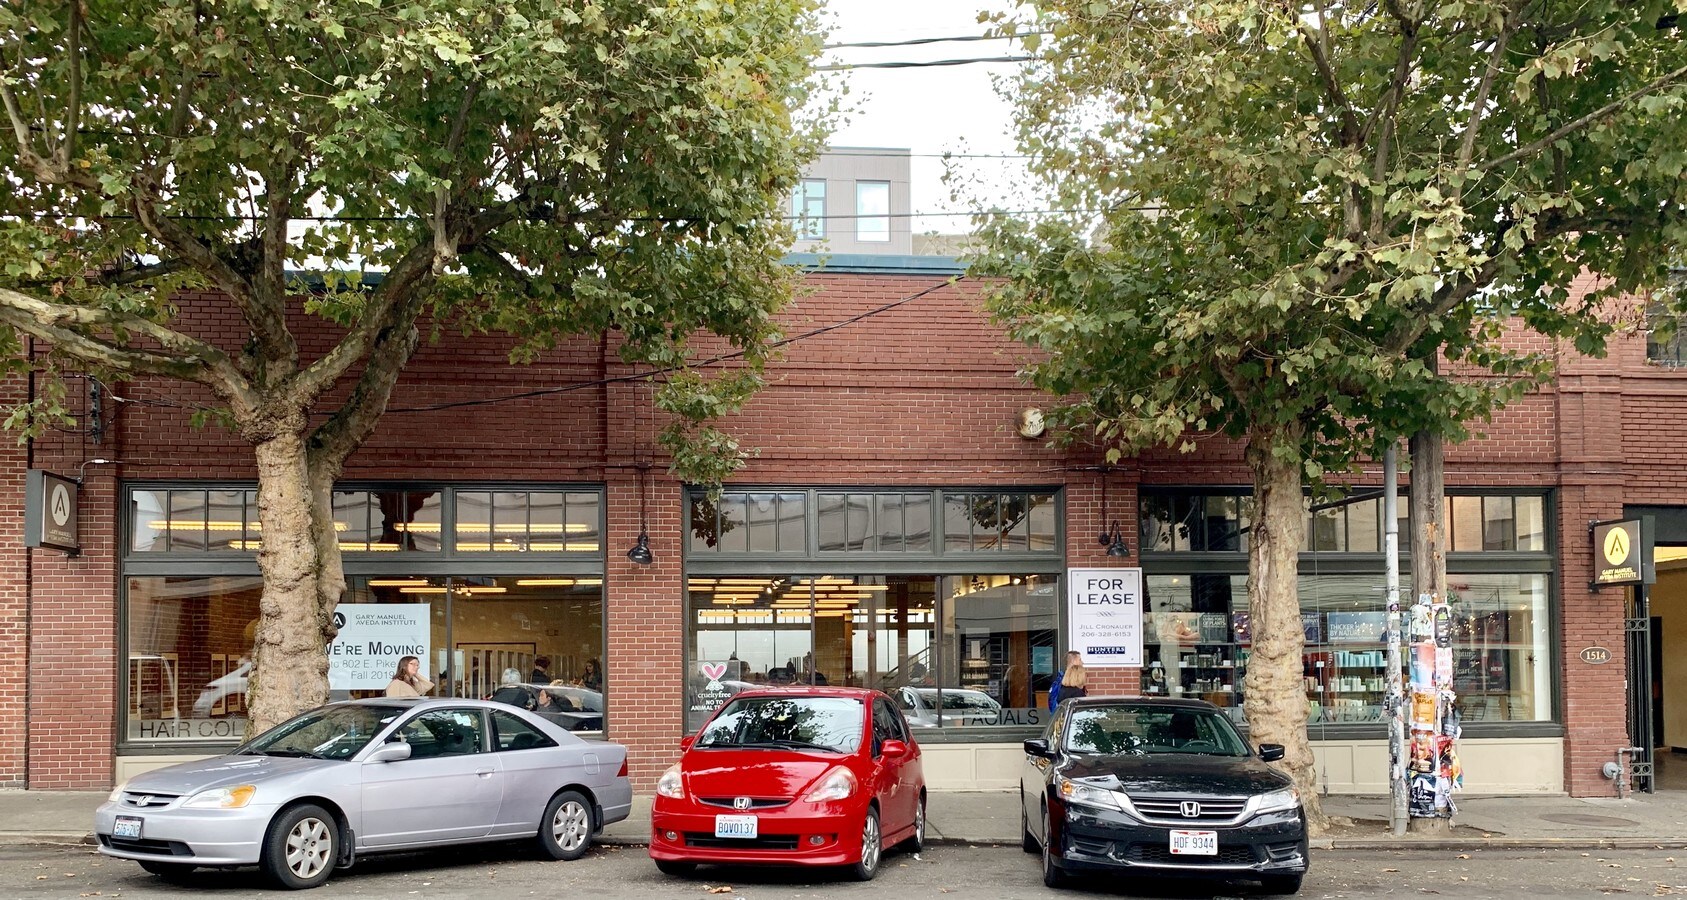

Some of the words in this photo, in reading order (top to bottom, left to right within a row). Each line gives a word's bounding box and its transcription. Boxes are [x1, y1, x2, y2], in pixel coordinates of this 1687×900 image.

[1088, 579, 1123, 590] FOR
[1077, 593, 1134, 604] LEASE
[368, 641, 424, 655] MOVING
[1586, 651, 1606, 660] 1514
[330, 660, 342, 668] to
[342, 660, 360, 668] 802
[363, 660, 373, 668] E.
[376, 659, 397, 668] Pike
[351, 670, 368, 679] Fall
[371, 671, 395, 679] 2019
[962, 709, 1040, 726] FACIALS
[140, 721, 191, 738] HAIR
[199, 720, 243, 737] COL
[1173, 837, 1189, 848] HDF
[1192, 837, 1213, 849] 9344
